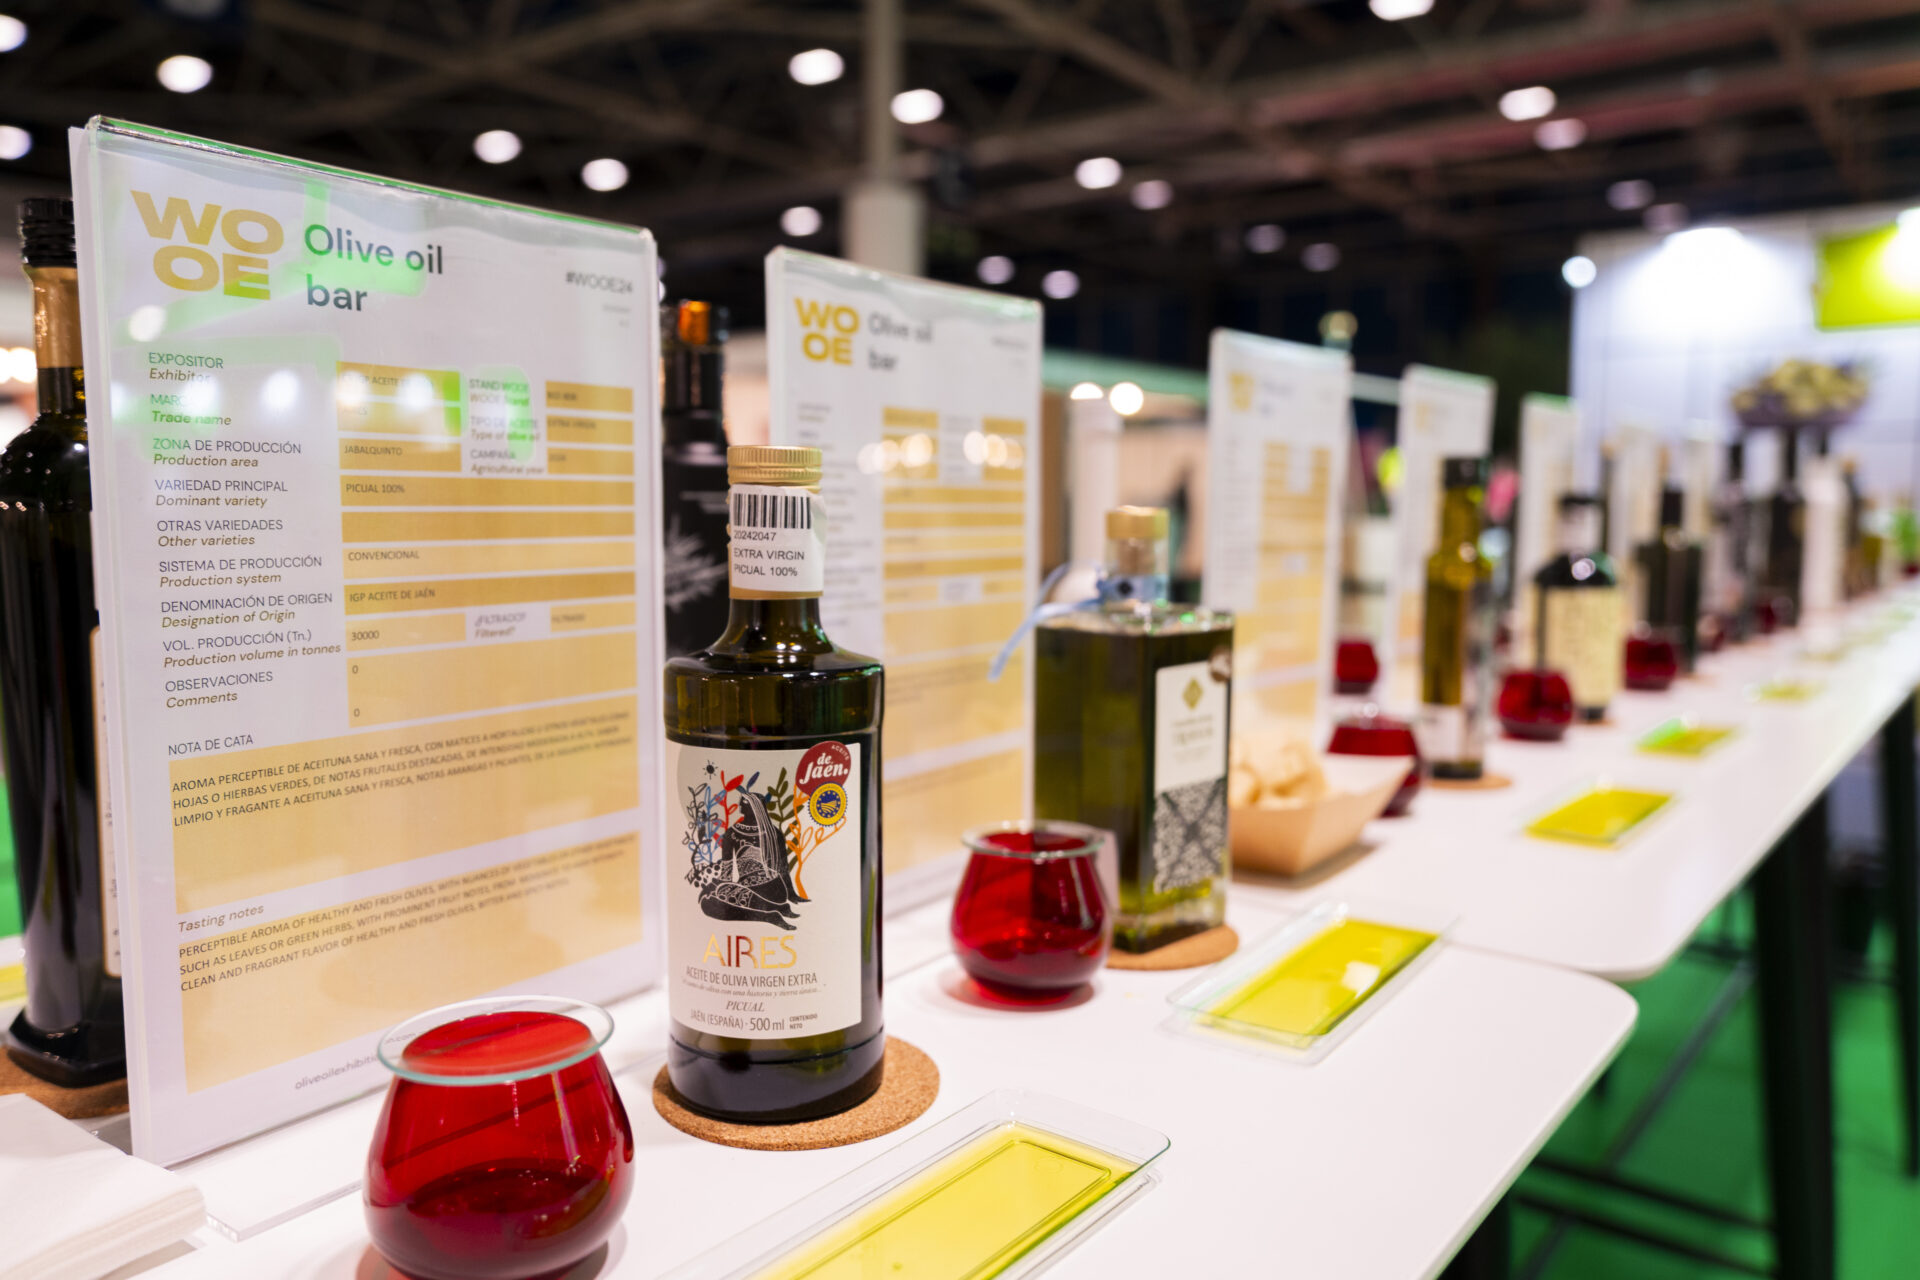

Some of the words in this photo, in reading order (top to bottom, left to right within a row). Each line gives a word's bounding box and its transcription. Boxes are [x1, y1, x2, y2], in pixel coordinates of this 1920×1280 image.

[131, 190, 284, 254] WO
[304, 224, 394, 266] Olive
[406, 244, 443, 274] oil
[153, 245, 271, 300] OE
[307, 273, 367, 311] bar
[566, 272, 633, 294] #WOOE24
[794, 298, 860, 335] WO
[802, 332, 852, 366] OE
[149, 352, 224, 369] EXPOSITOR
[868, 347, 897, 371] bar
[150, 368, 210, 382] Exhibitor
[152, 411, 191, 423] Trade
[195, 416, 232, 425] name
[153, 438, 191, 450] ZONA
[195, 439, 212, 451] DE
[217, 440, 301, 454] PRODUCCIÓN
[344, 445, 402, 456] JABALQUINTO
[153, 454, 227, 467] Production
[231, 458, 259, 467] area
[155, 479, 221, 491] VARIEDAD
[225, 480, 288, 492] PRINCIPAL
[346, 483, 378, 493] PICUAL
[382, 484, 405, 494] 100%
[156, 495, 220, 506] Dominant
[225, 495, 268, 508] variety
[157, 520, 201, 532] OTRAS
[205, 519, 283, 531] VARIEDADES
[158, 536, 197, 547] Other
[201, 535, 255, 546] varieties
[734, 530, 776, 541] 20242047
[348, 550, 420, 561] CONVENCIONAL
[734, 547, 763, 559] EXTRA
[767, 550, 805, 561] VIRGIN
[159, 560, 215, 573] SISTEMA
[219, 559, 236, 570] DE
[240, 555, 322, 569] PRODUCCIÓN
[734, 563, 766, 576] PICUAL
[770, 567, 798, 577] 100%
[160, 574, 232, 588] Production
[236, 574, 282, 587] system
[161, 594, 265, 613] DENOMINACIÓN
[268, 595, 284, 607] DE
[288, 593, 333, 604] ORIGEN
[349, 593, 365, 602] IGP
[368, 591, 398, 602] ACEITE
[401, 590, 412, 599] DE
[415, 587, 435, 599] JAÉN
[162, 613, 239, 629] Designation
[243, 611, 256, 622] of
[259, 610, 296, 623] Origin
[163, 639, 195, 652] VOL.
[198, 631, 283, 649] PRODUCCIÓN
[287, 629, 312, 643] (Tn.)
[351, 630, 379, 641] 30000
[164, 651, 236, 668] Production
[239, 647, 284, 661] volume
[287, 647, 299, 657] in
[302, 645, 341, 656] tonnes
[165, 671, 273, 692] OBSERVACIONES
[166, 692, 238, 709] Comments
[168, 741, 201, 756] NOTA
[205, 739, 221, 751] DE
[224, 734, 253, 748] CATA
[172, 777, 216, 792] AROMA
[218, 766, 284, 785] PERCEPTIBLE
[287, 763, 300, 774] DE
[303, 753, 352, 771] ACEITUNA
[353, 751, 378, 763] SANA
[381, 749, 387, 757] Y
[388, 744, 422, 757] FRESCA,
[425, 741, 443, 752] CON
[445, 734, 480, 748] MATICES
[817, 752, 832, 765] de
[173, 796, 209, 809] HOJAS
[211, 793, 220, 803] O
[223, 784, 267, 801] HIERBAS
[269, 778, 311, 793] VERDES,
[313, 775, 326, 785] DE
[328, 769, 361, 782] NOTAS
[363, 760, 407, 777] FRUTALES
[174, 811, 214, 827] LIMPIO
[217, 808, 224, 818] Y
[226, 799, 281, 817] FRAGANTE
[283, 797, 291, 806] A
[293, 787, 342, 804] ACEITUNA
[344, 783, 370, 796] SANA
[372, 781, 378, 789] Y
[416, 769, 445, 782] NOTAS
[178, 914, 225, 932] Tasting
[229, 905, 264, 921] notes
[179, 932, 248, 958] PERCEPTIBLE
[250, 922, 290, 939] AROMA
[292, 918, 307, 928] OF
[309, 907, 350, 925] HEALTHY
[352, 901, 373, 913] AND
[375, 894, 402, 909] FRESH
[179, 959, 210, 975] SUCH
[213, 954, 227, 966] AS
[229, 944, 267, 962] LEAVES
[269, 940, 284, 951] OR
[286, 930, 320, 946] GREEN
[322, 920, 354, 937] HERBS,
[356, 913, 381, 928] WITH
[383, 900, 436, 920] PROMINENT
[181, 974, 216, 992] CLEAN
[219, 966, 243, 981] AND
[245, 950, 300, 974] FRAGRANT
[302, 938, 340, 958] FLAVOR
[341, 936, 354, 948] OF
[356, 925, 397, 943] HEALTHY
[398, 918, 418, 931] AND
[419, 912, 446, 925] FRESH
[702, 933, 797, 969] AIRES
[686, 965, 708, 983] ACEITE
[709, 972, 720, 985] DE
[722, 974, 748, 987] OLIVA
[750, 975, 786, 988] VIRGEN
[788, 972, 818, 986] EXTRA
[725, 1000, 765, 1012] PICUAL
[690, 1009, 706, 1022] JAÉN
[707, 1012, 744, 1030] (ESPAÑA)
[750, 1017, 771, 1031] 500
[772, 1019, 785, 1031] ml
[789, 1013, 818, 1022] CONTENIDO
[790, 1022, 803, 1030] NETO
